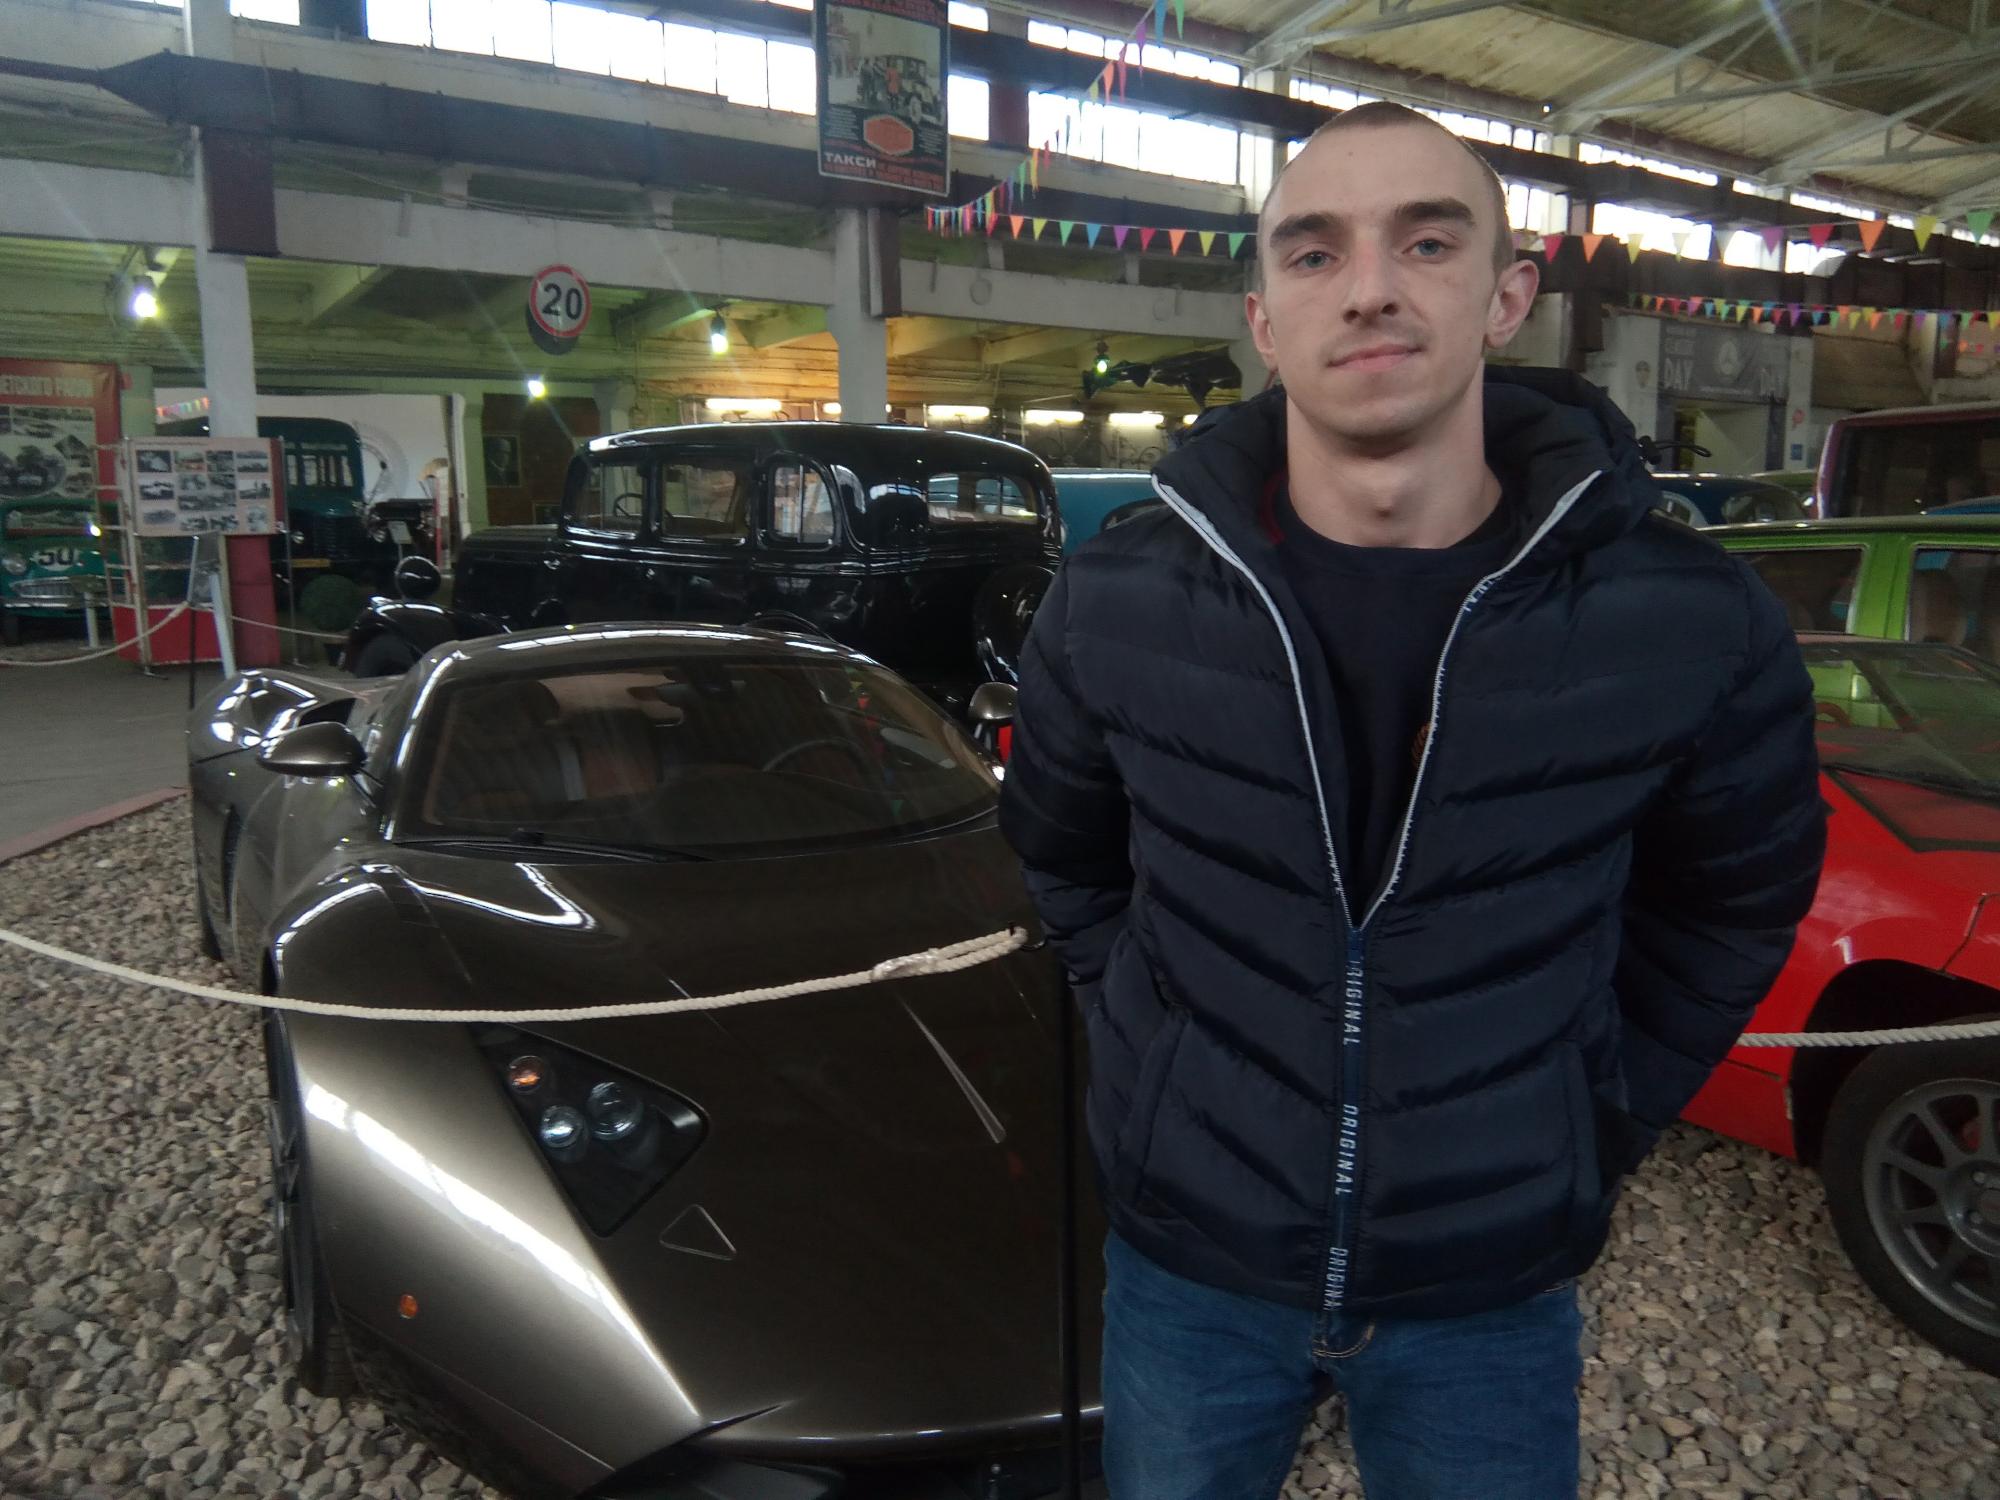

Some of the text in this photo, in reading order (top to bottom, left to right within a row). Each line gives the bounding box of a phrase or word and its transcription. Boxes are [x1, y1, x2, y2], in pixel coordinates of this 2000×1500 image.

[824, 152, 877, 169] ТАКСИ
[543, 283, 582, 320] 20
[1335, 1103, 1360, 1196] ORIGINAL
